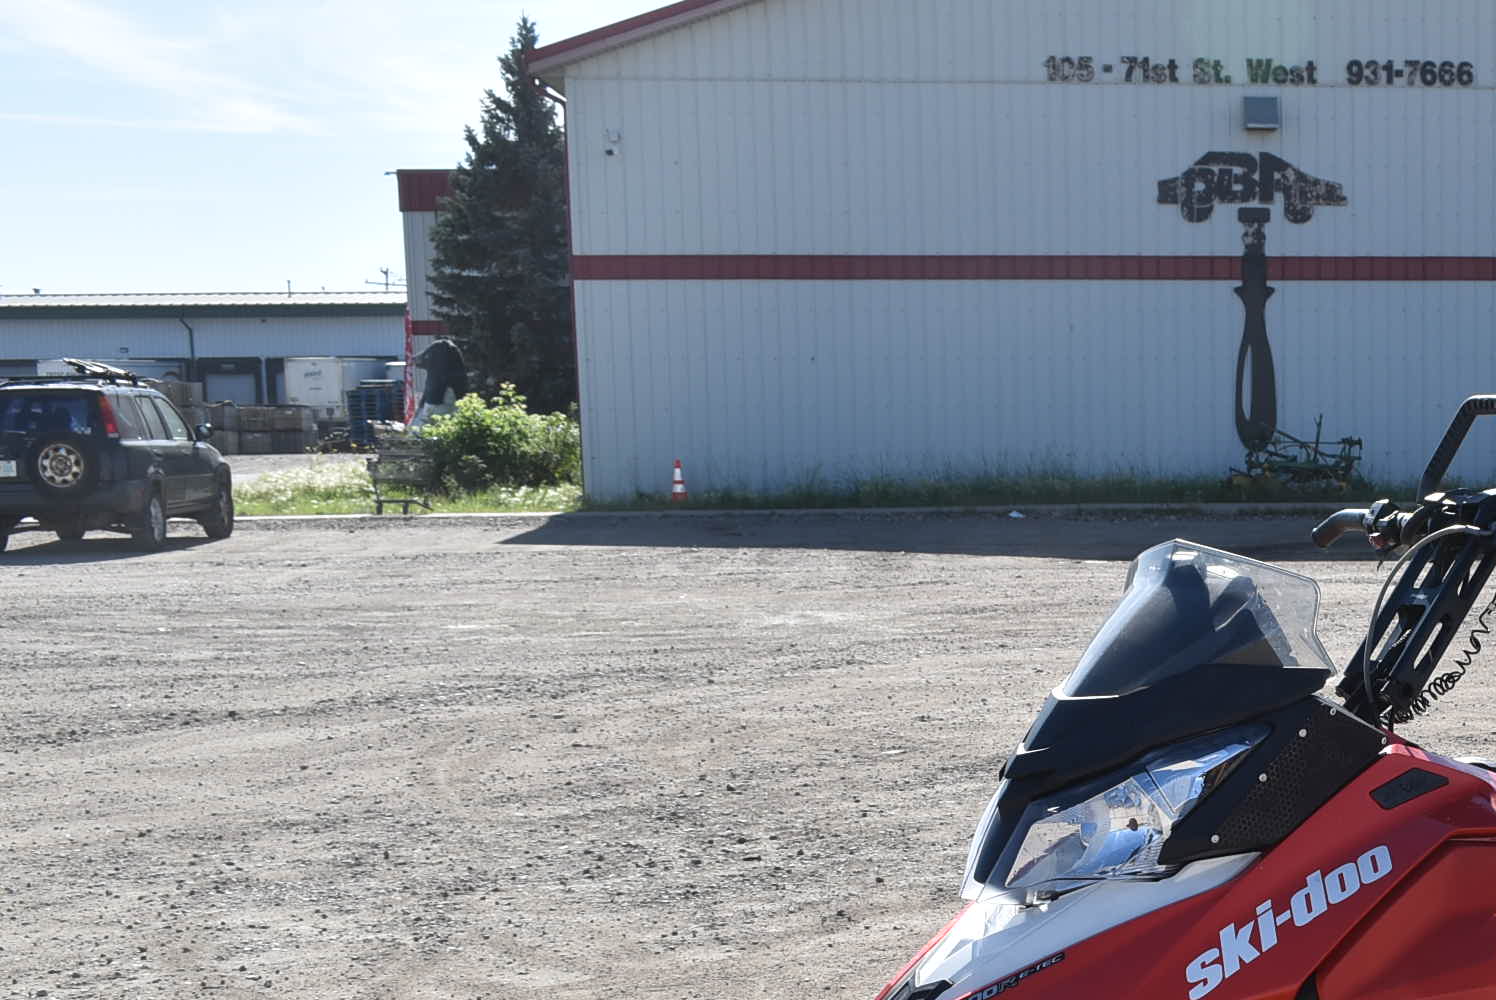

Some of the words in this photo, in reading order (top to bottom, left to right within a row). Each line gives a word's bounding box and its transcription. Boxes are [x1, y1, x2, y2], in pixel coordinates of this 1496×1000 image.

[1043, 55, 1095, 82] 105
[1121, 55, 1179, 83] 71st
[1193, 57, 1231, 84] St.
[1246, 58, 1317, 85] West
[1347, 59, 1474, 87] 931-7666
[1185, 845, 1393, 1000] ski-doo
